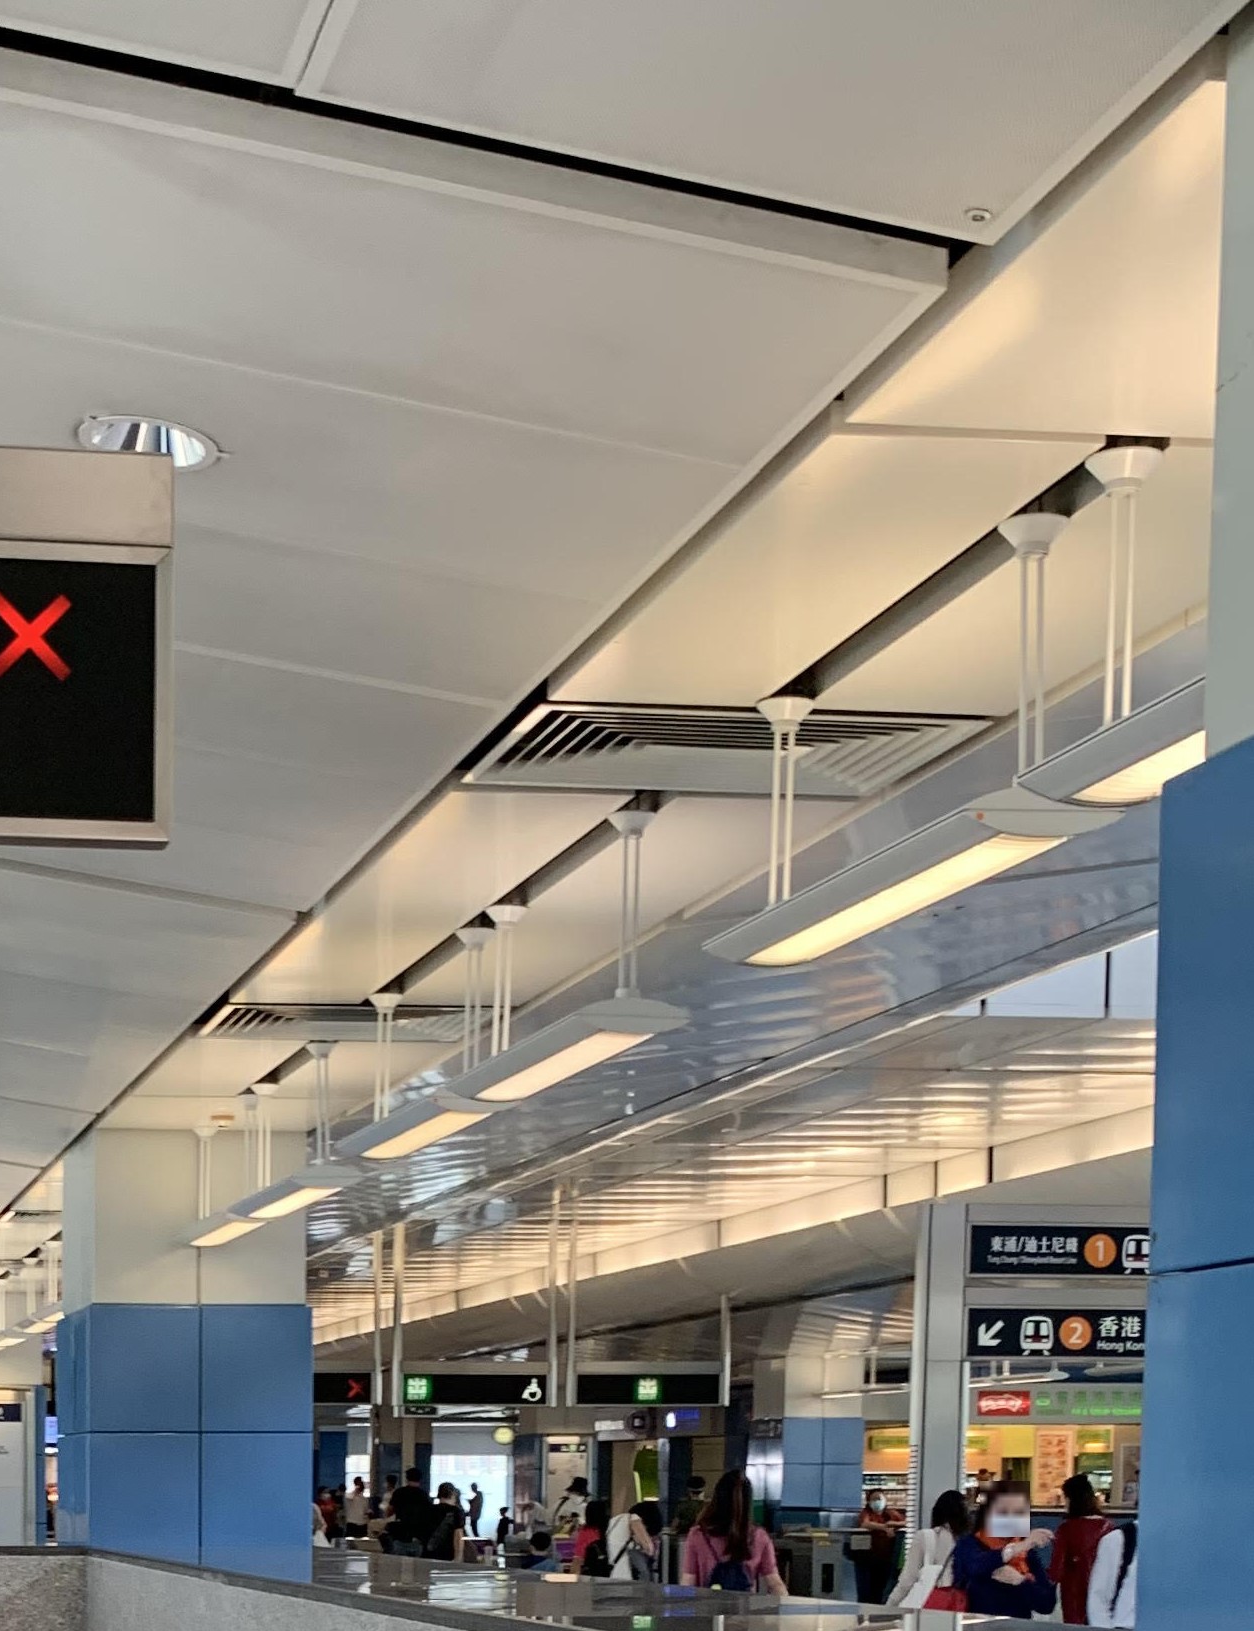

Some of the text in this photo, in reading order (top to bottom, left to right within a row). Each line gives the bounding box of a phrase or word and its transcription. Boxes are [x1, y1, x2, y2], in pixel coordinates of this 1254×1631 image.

[1095, 1240, 1105, 1262] 1
[1069, 1323, 1084, 1344] 2
[1098, 1316, 1142, 1338] 香港
[1096, 1340, 1146, 1353] Hong Kon
